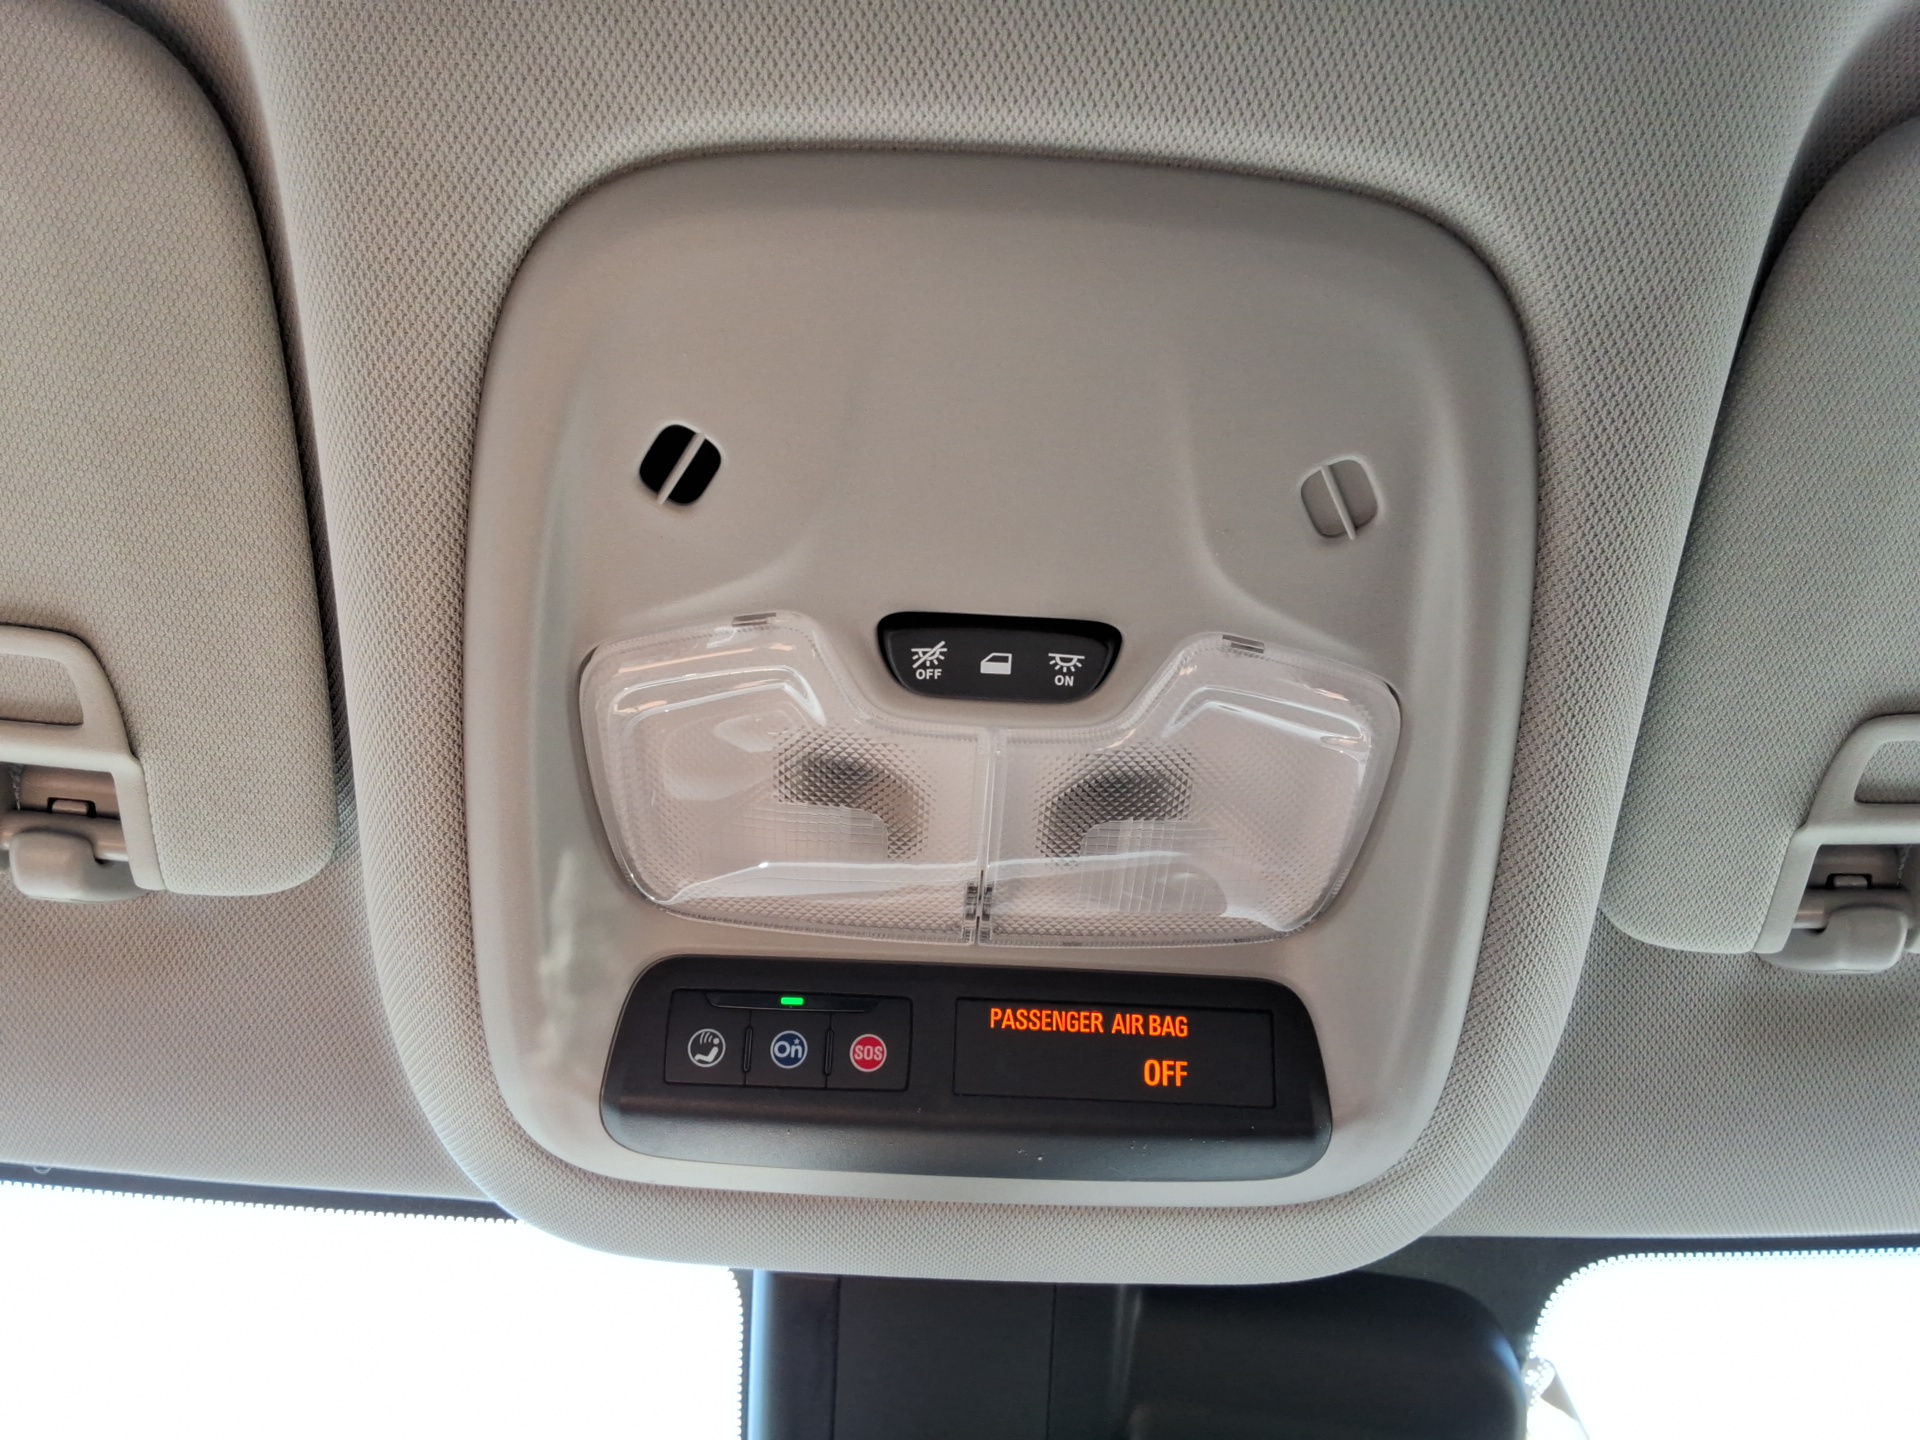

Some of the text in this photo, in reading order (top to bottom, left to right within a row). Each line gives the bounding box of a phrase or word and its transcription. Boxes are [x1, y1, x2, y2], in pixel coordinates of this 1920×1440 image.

[915, 668, 943, 680] OFF
[1054, 675, 1074, 687] ON
[989, 1007, 1189, 1038] PASSENGER AIR BAG
[773, 1040, 802, 1059] On
[854, 1044, 883, 1061] SOS
[1143, 1058, 1188, 1087] OFF
